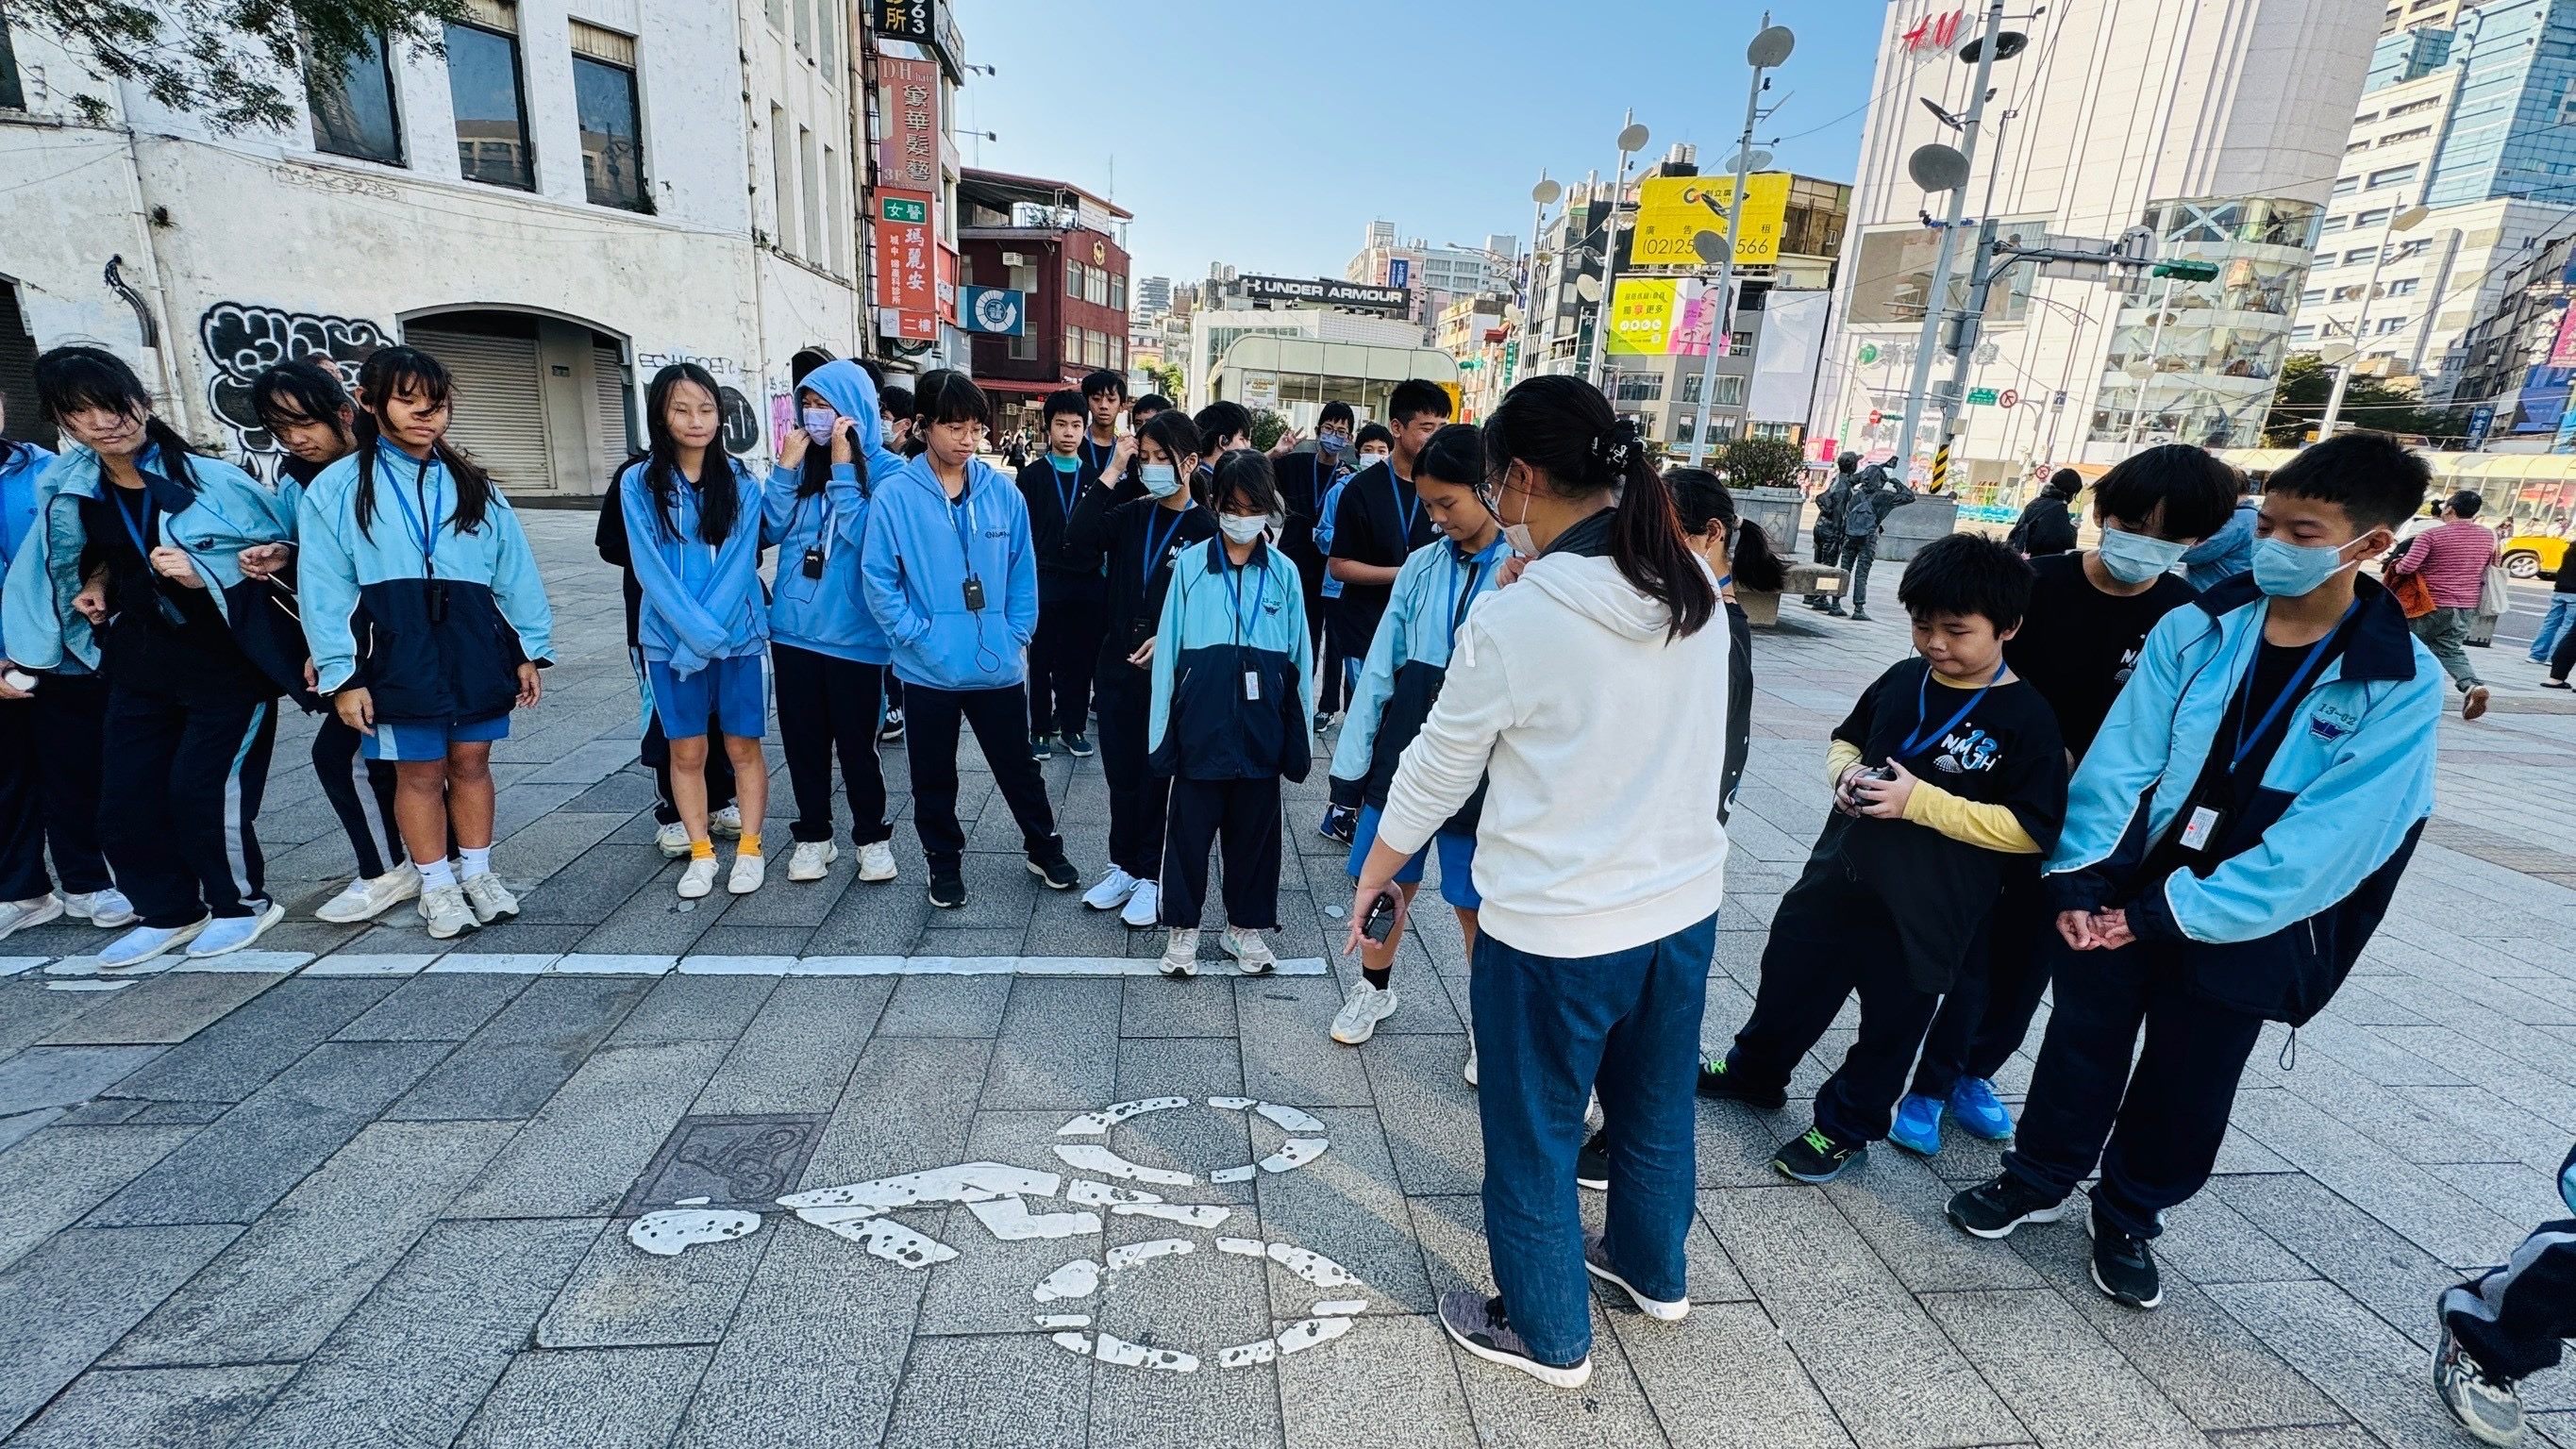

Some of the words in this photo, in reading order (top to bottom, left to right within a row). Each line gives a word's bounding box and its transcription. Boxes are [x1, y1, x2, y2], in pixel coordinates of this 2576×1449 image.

[883, 0, 907, 32] 所
[911, 0, 926, 34] 63
[882, 59, 912, 81] DH
[887, 202, 923, 220] 女醫
[904, 227, 926, 291] 瑪麗安
[1264, 280, 1323, 297] UNDER
[1328, 287, 1403, 304] ARMOUR
[903, 317, 932, 333] 二樓
